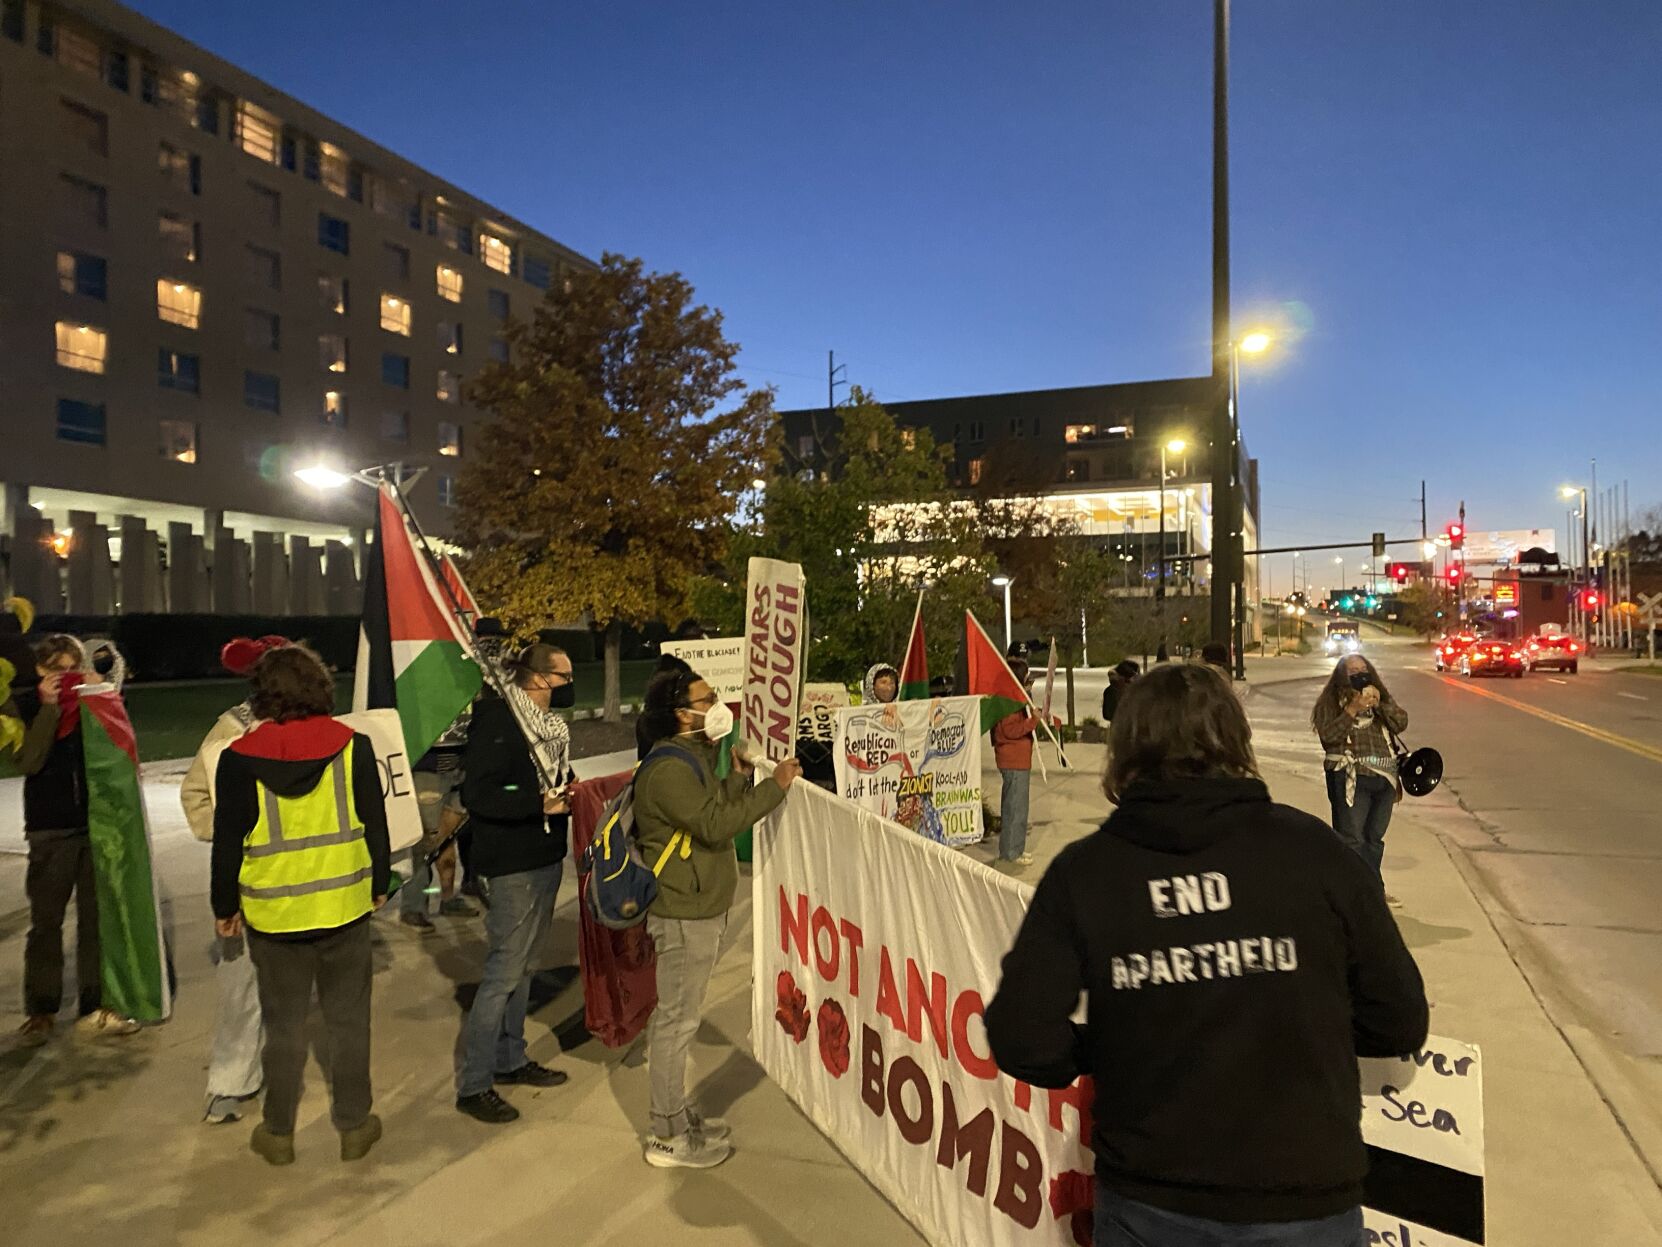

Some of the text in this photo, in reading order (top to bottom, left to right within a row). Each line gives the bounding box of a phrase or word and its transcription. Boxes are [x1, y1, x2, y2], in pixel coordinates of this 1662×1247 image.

[745, 582, 771, 745] 75 YEARS
[766, 583, 799, 764] ENOUGH
[798, 717, 815, 741] RMS
[930, 723, 965, 746] Democrat
[937, 736, 956, 751] BLUE
[866, 751, 889, 768] RED
[909, 749, 919, 759] or
[868, 777, 879, 796] let
[881, 776, 898, 795] the
[899, 773, 933, 797] ZIONIST
[935, 771, 968, 788] KOOL-AID
[943, 810, 975, 837] YOU!
[1147, 871, 1232, 918] END
[779, 884, 863, 998] NOT
[1111, 936, 1298, 989] APARTHEID
[861, 1022, 1043, 1230] BOMB
[1381, 1085, 1461, 1135] Sea
